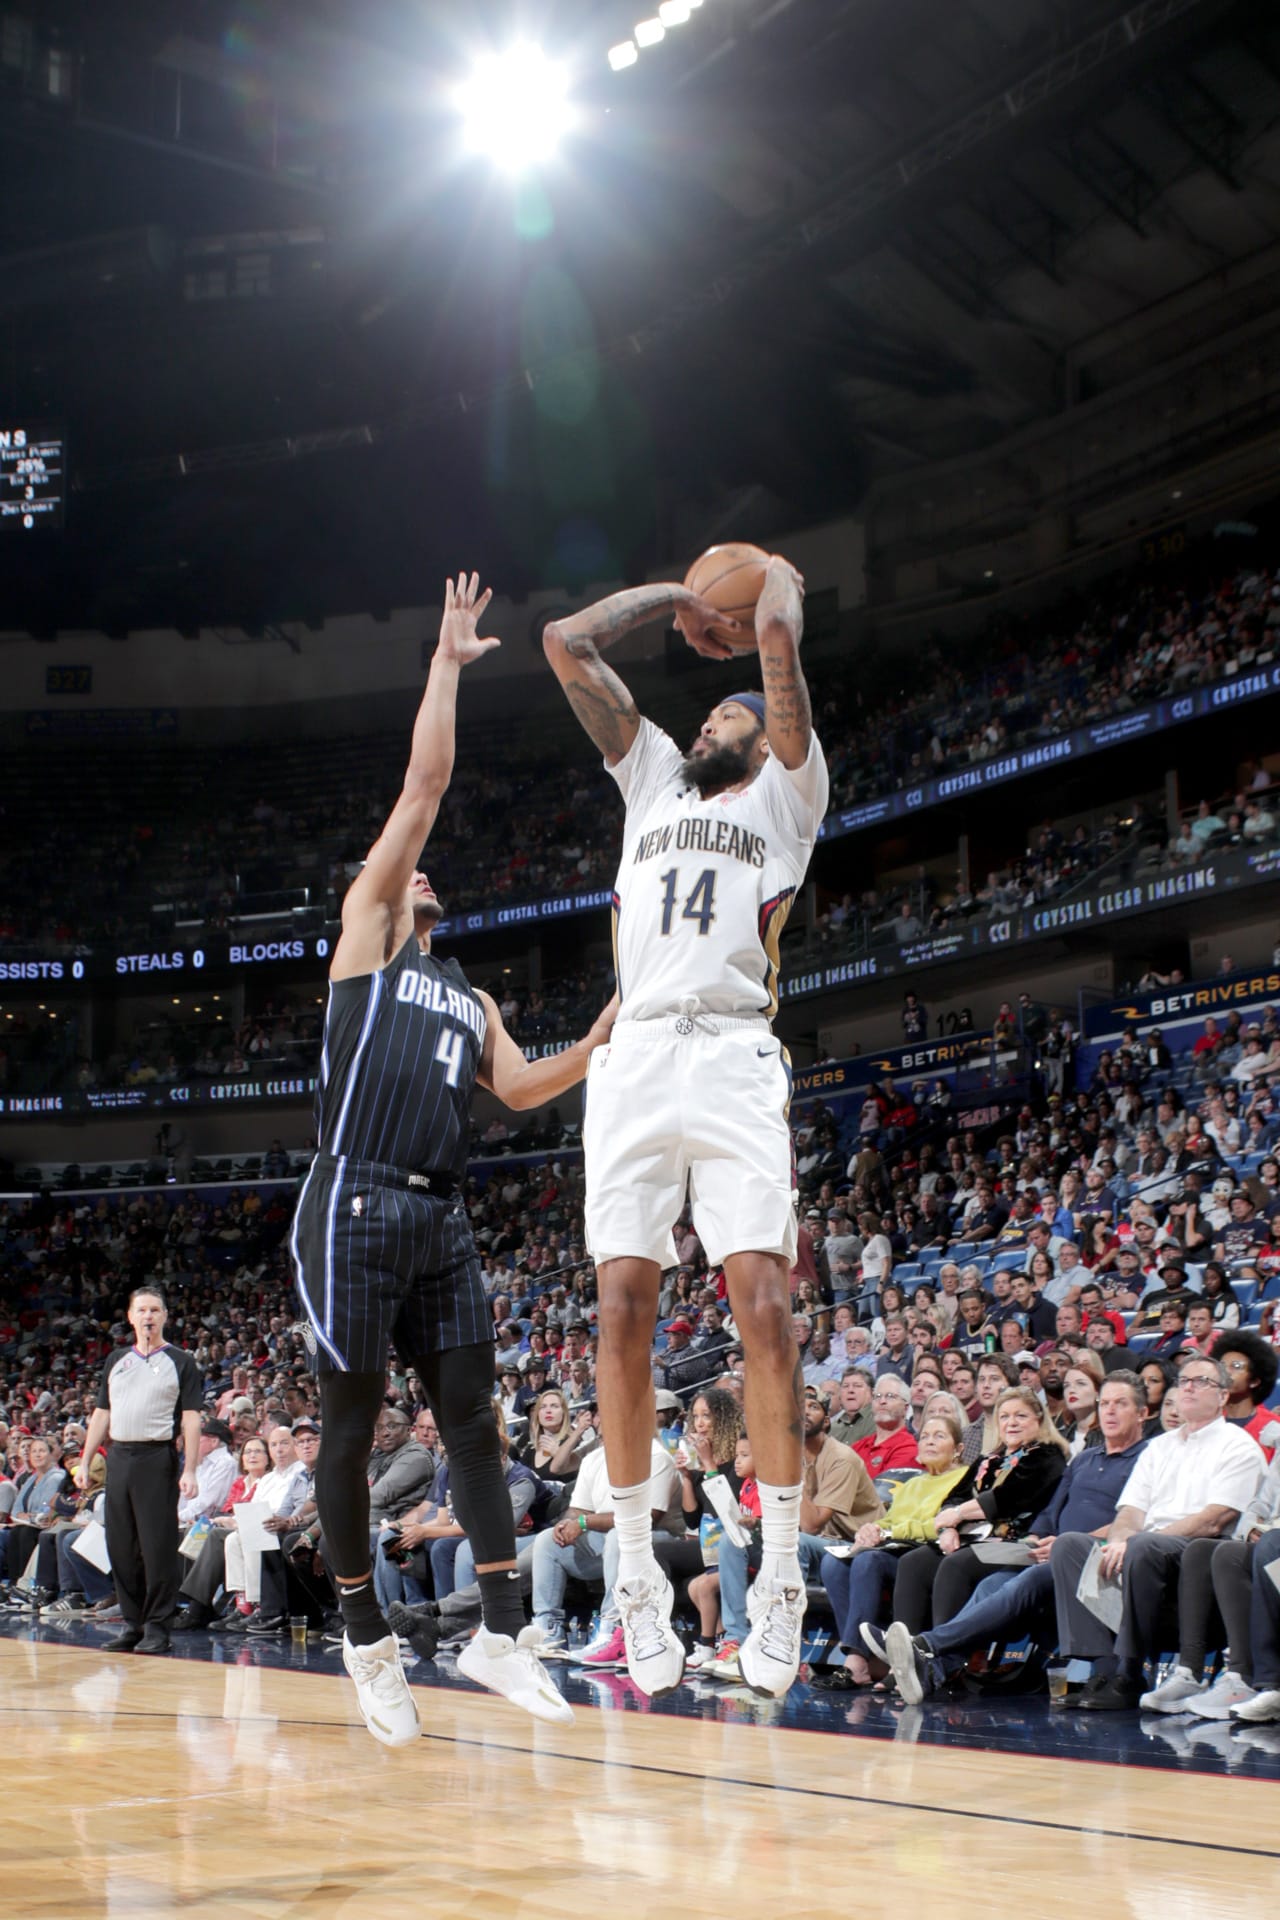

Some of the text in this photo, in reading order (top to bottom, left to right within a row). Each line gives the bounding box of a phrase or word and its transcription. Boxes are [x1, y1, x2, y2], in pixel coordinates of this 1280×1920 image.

[1213, 673, 1269, 705] CRYSTAL
[938, 772, 982, 796] CRYSTAL
[985, 757, 1018, 781] CLEAR
[1022, 739, 1071, 768] IMAGING
[633, 818, 767, 869] NEW ORLEANS
[498, 907, 538, 923] CRYSTAL
[542, 898, 571, 914] CLEAR
[575, 891, 612, 909] IMAGIN
[660, 867, 719, 936] 14
[1033, 867, 1216, 931] CRYSTAL CLEAR IMAGING
[72, 961, 84, 979] 0
[116, 952, 184, 973] STEALS
[193, 950, 205, 968] 0
[229, 941, 304, 963] BLOCKS
[316, 938, 328, 957] 0
[788, 972, 821, 995] CLEAR
[826, 958, 876, 985] IMAGING
[396, 969, 487, 1056] ORLAND
[1151, 974, 1280, 1016] BETRIVERS
[435, 1026, 465, 1089] 4
[9, 1097, 63, 1111] IMAGING
[210, 1080, 261, 1098] CRYSTAL
[267, 1079, 303, 1095] CLEAR
